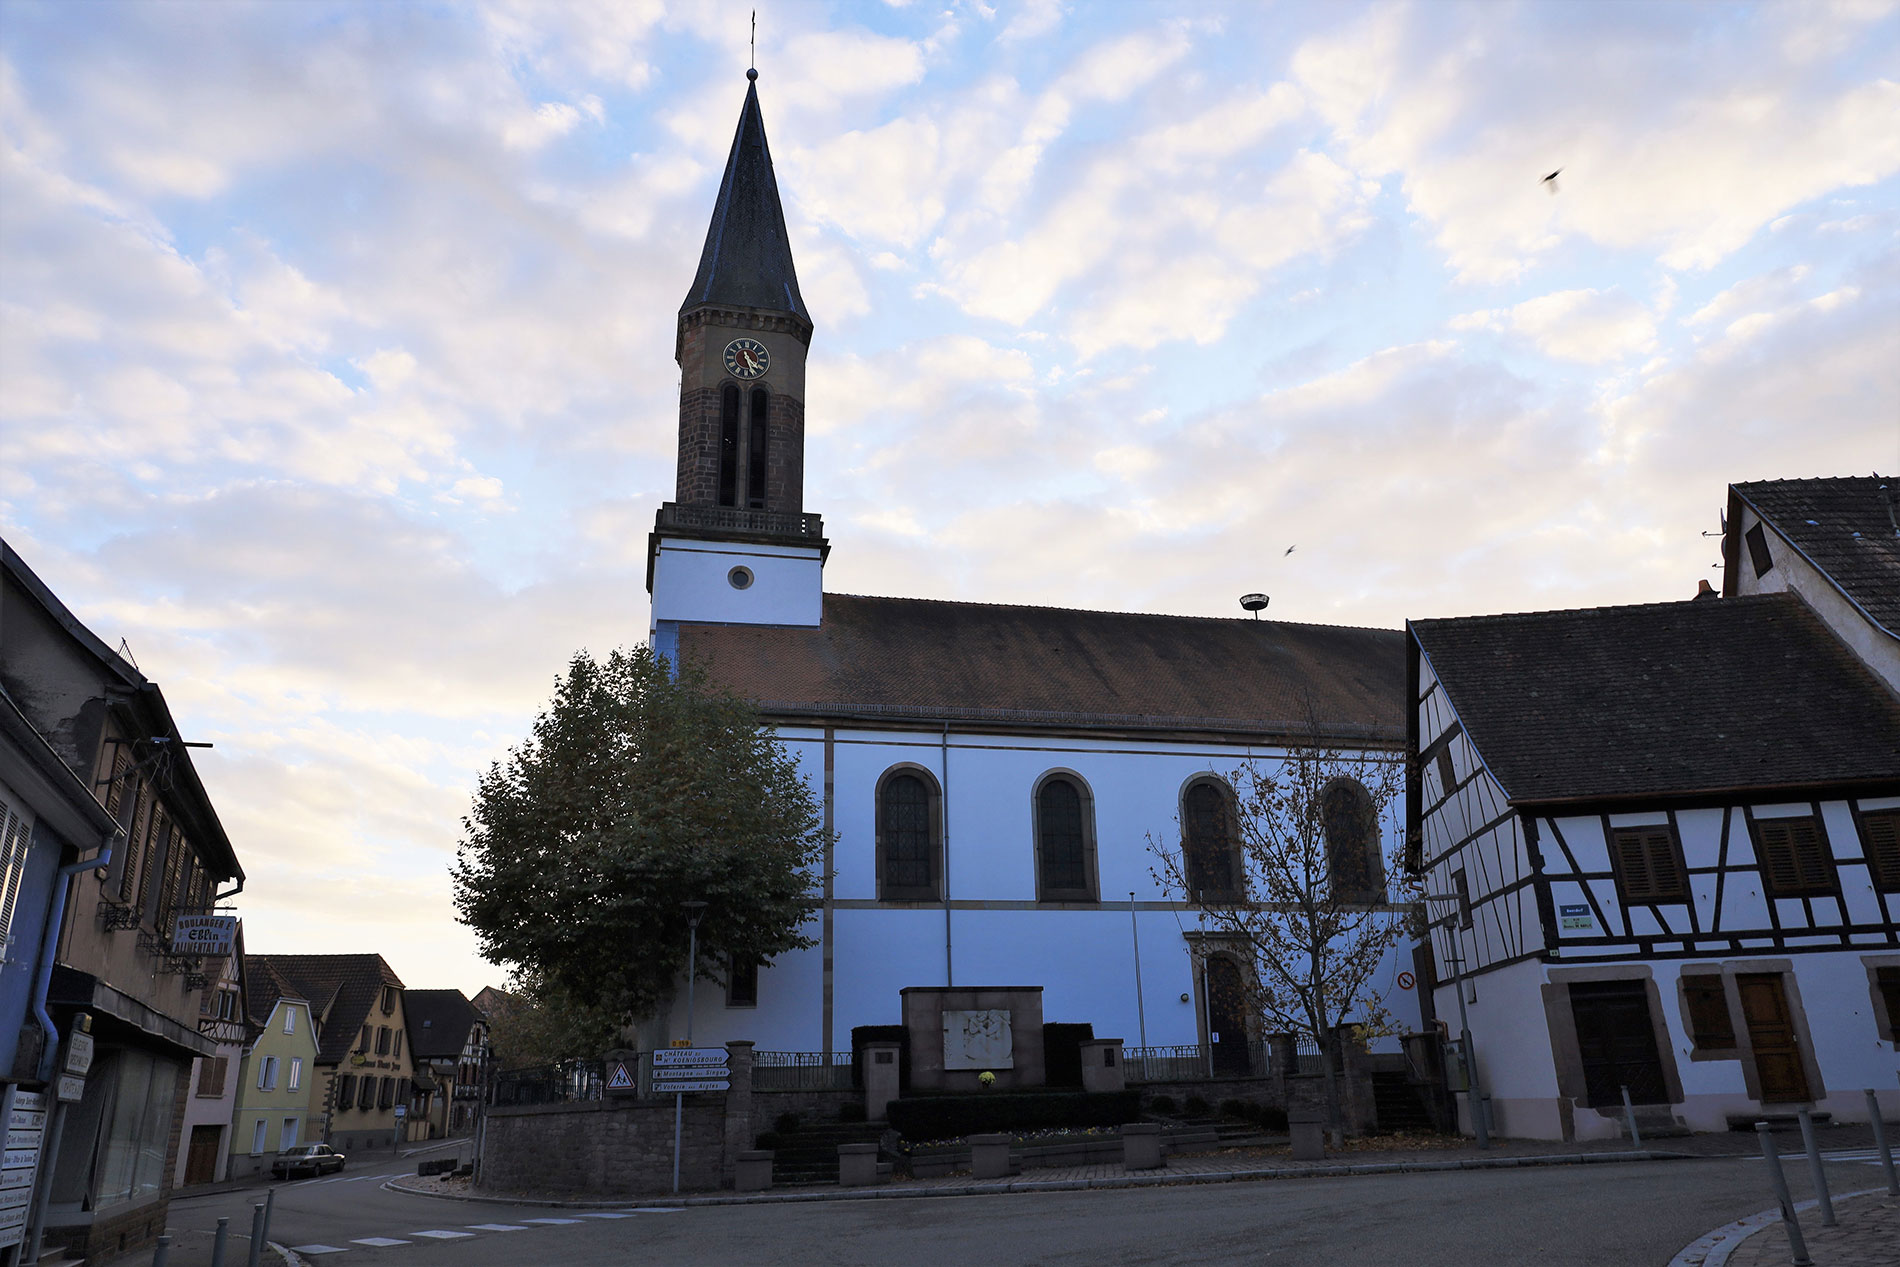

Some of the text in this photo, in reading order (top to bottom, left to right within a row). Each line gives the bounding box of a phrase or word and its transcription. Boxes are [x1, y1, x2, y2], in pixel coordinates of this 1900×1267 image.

[179, 918, 232, 930] BOULANGERE
[175, 942, 229, 953] ALIMENTATON
[706, 1069, 726, 1077] Singes
